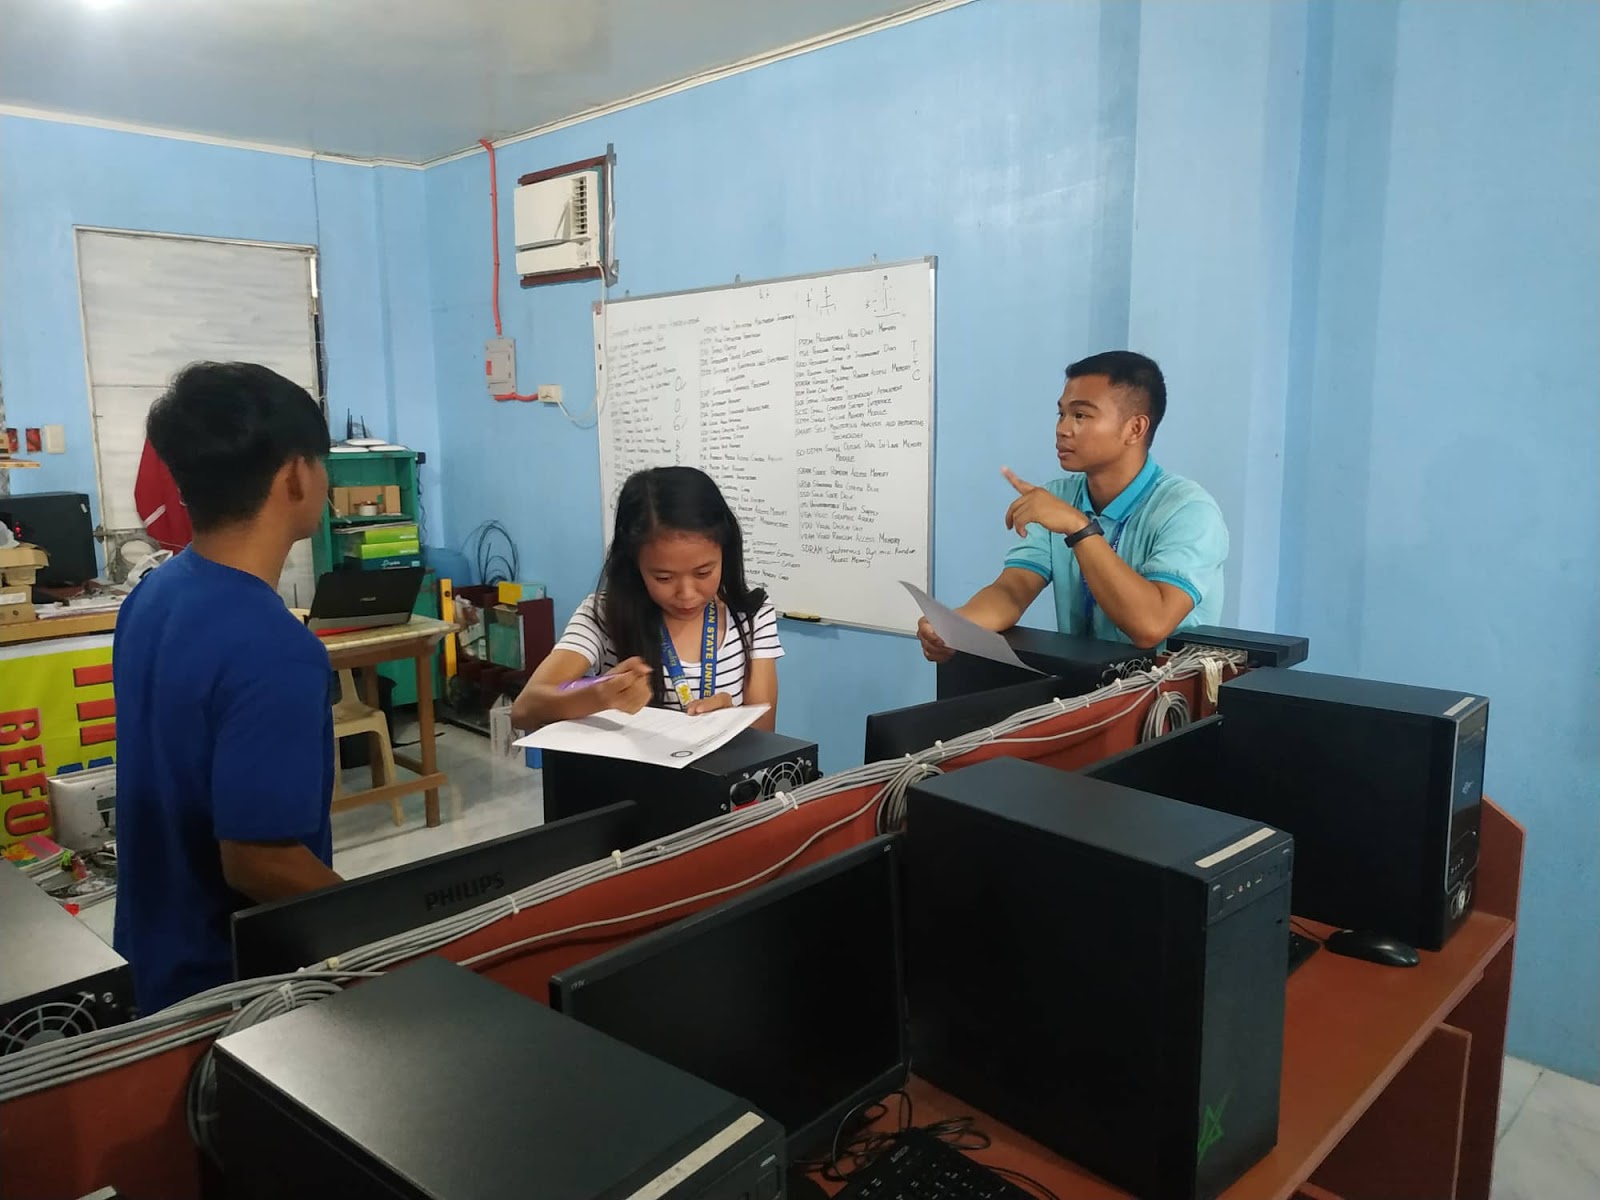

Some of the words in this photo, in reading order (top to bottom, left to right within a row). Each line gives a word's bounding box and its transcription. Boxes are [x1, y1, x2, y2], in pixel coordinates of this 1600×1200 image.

[705, 626, 716, 660] STATE
[0, 706, 52, 838] BEFO
[423, 871, 506, 912] PHILIPS
